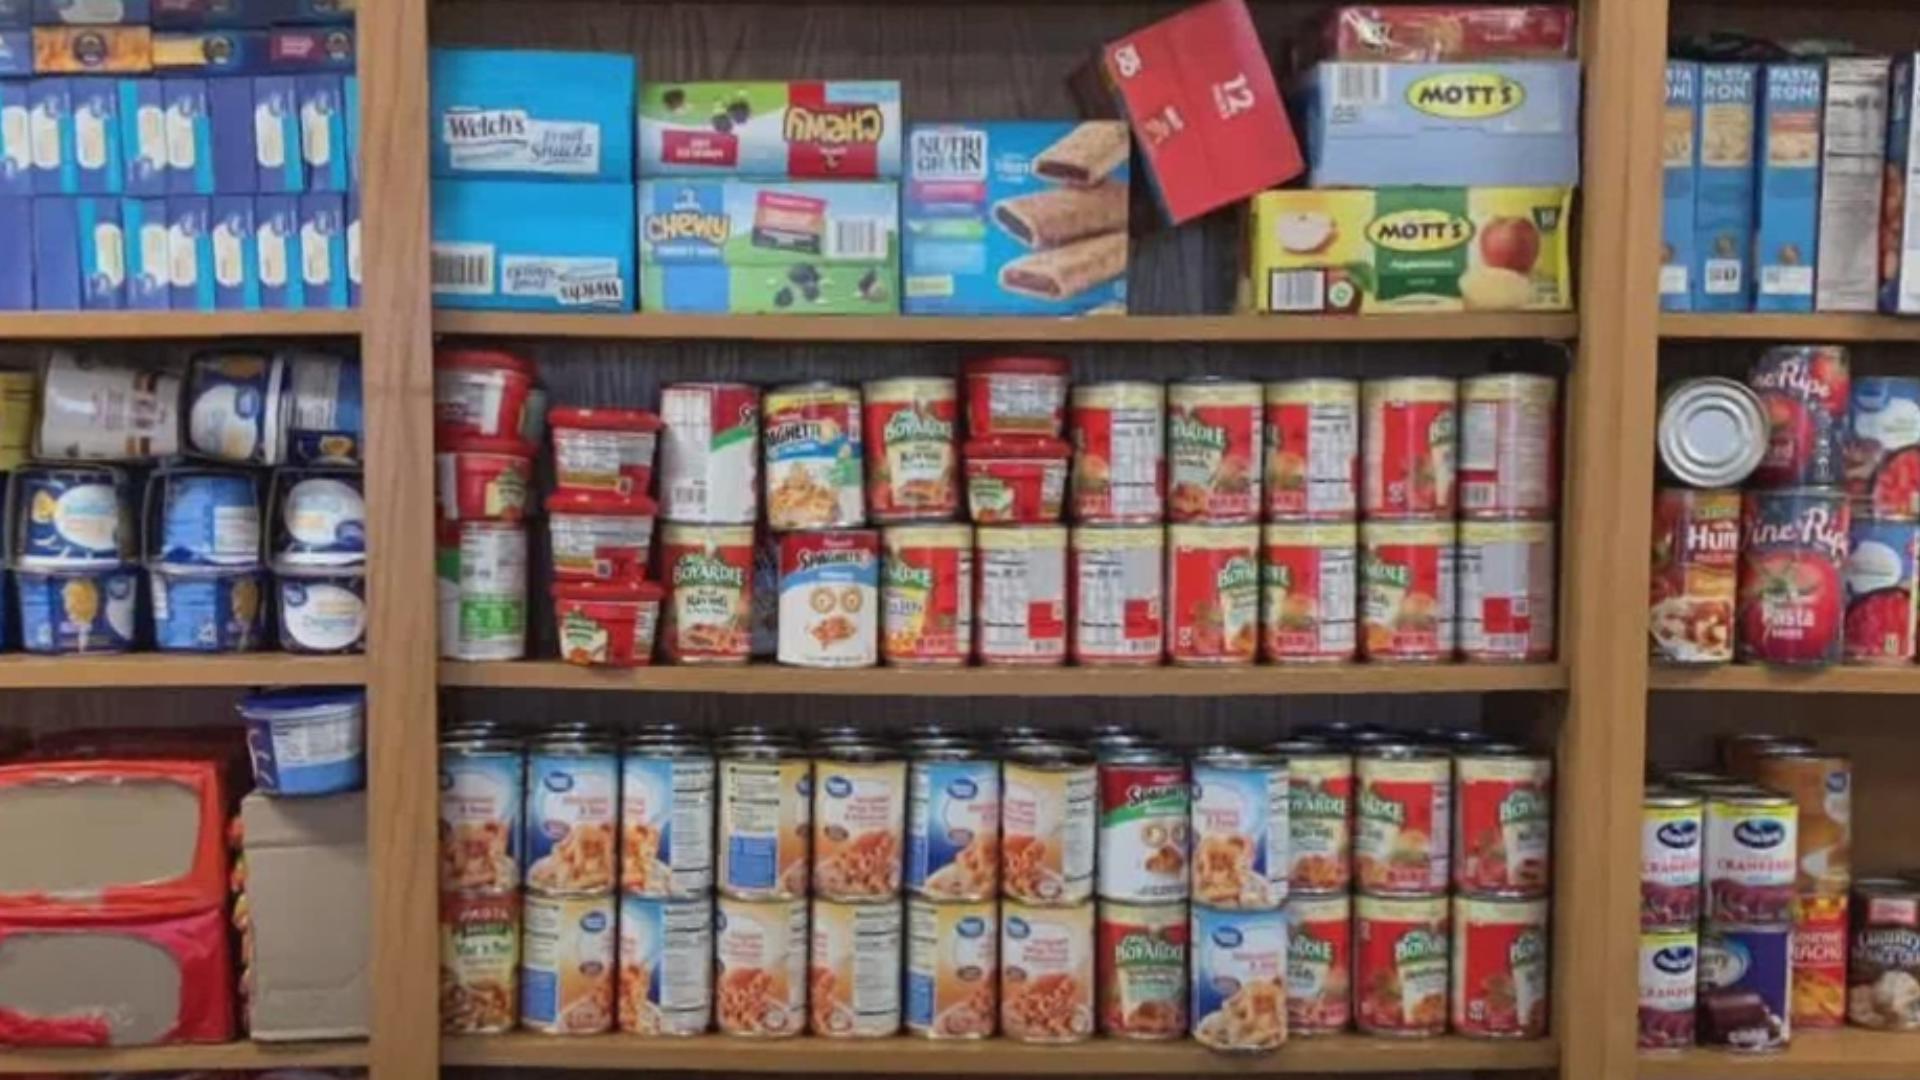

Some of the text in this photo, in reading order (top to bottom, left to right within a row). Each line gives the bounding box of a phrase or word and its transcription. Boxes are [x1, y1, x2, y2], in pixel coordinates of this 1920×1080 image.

[449, 112, 526, 138] Welch's
[917, 135, 984, 152] NUTRI
[917, 153, 984, 173] GRAIN
